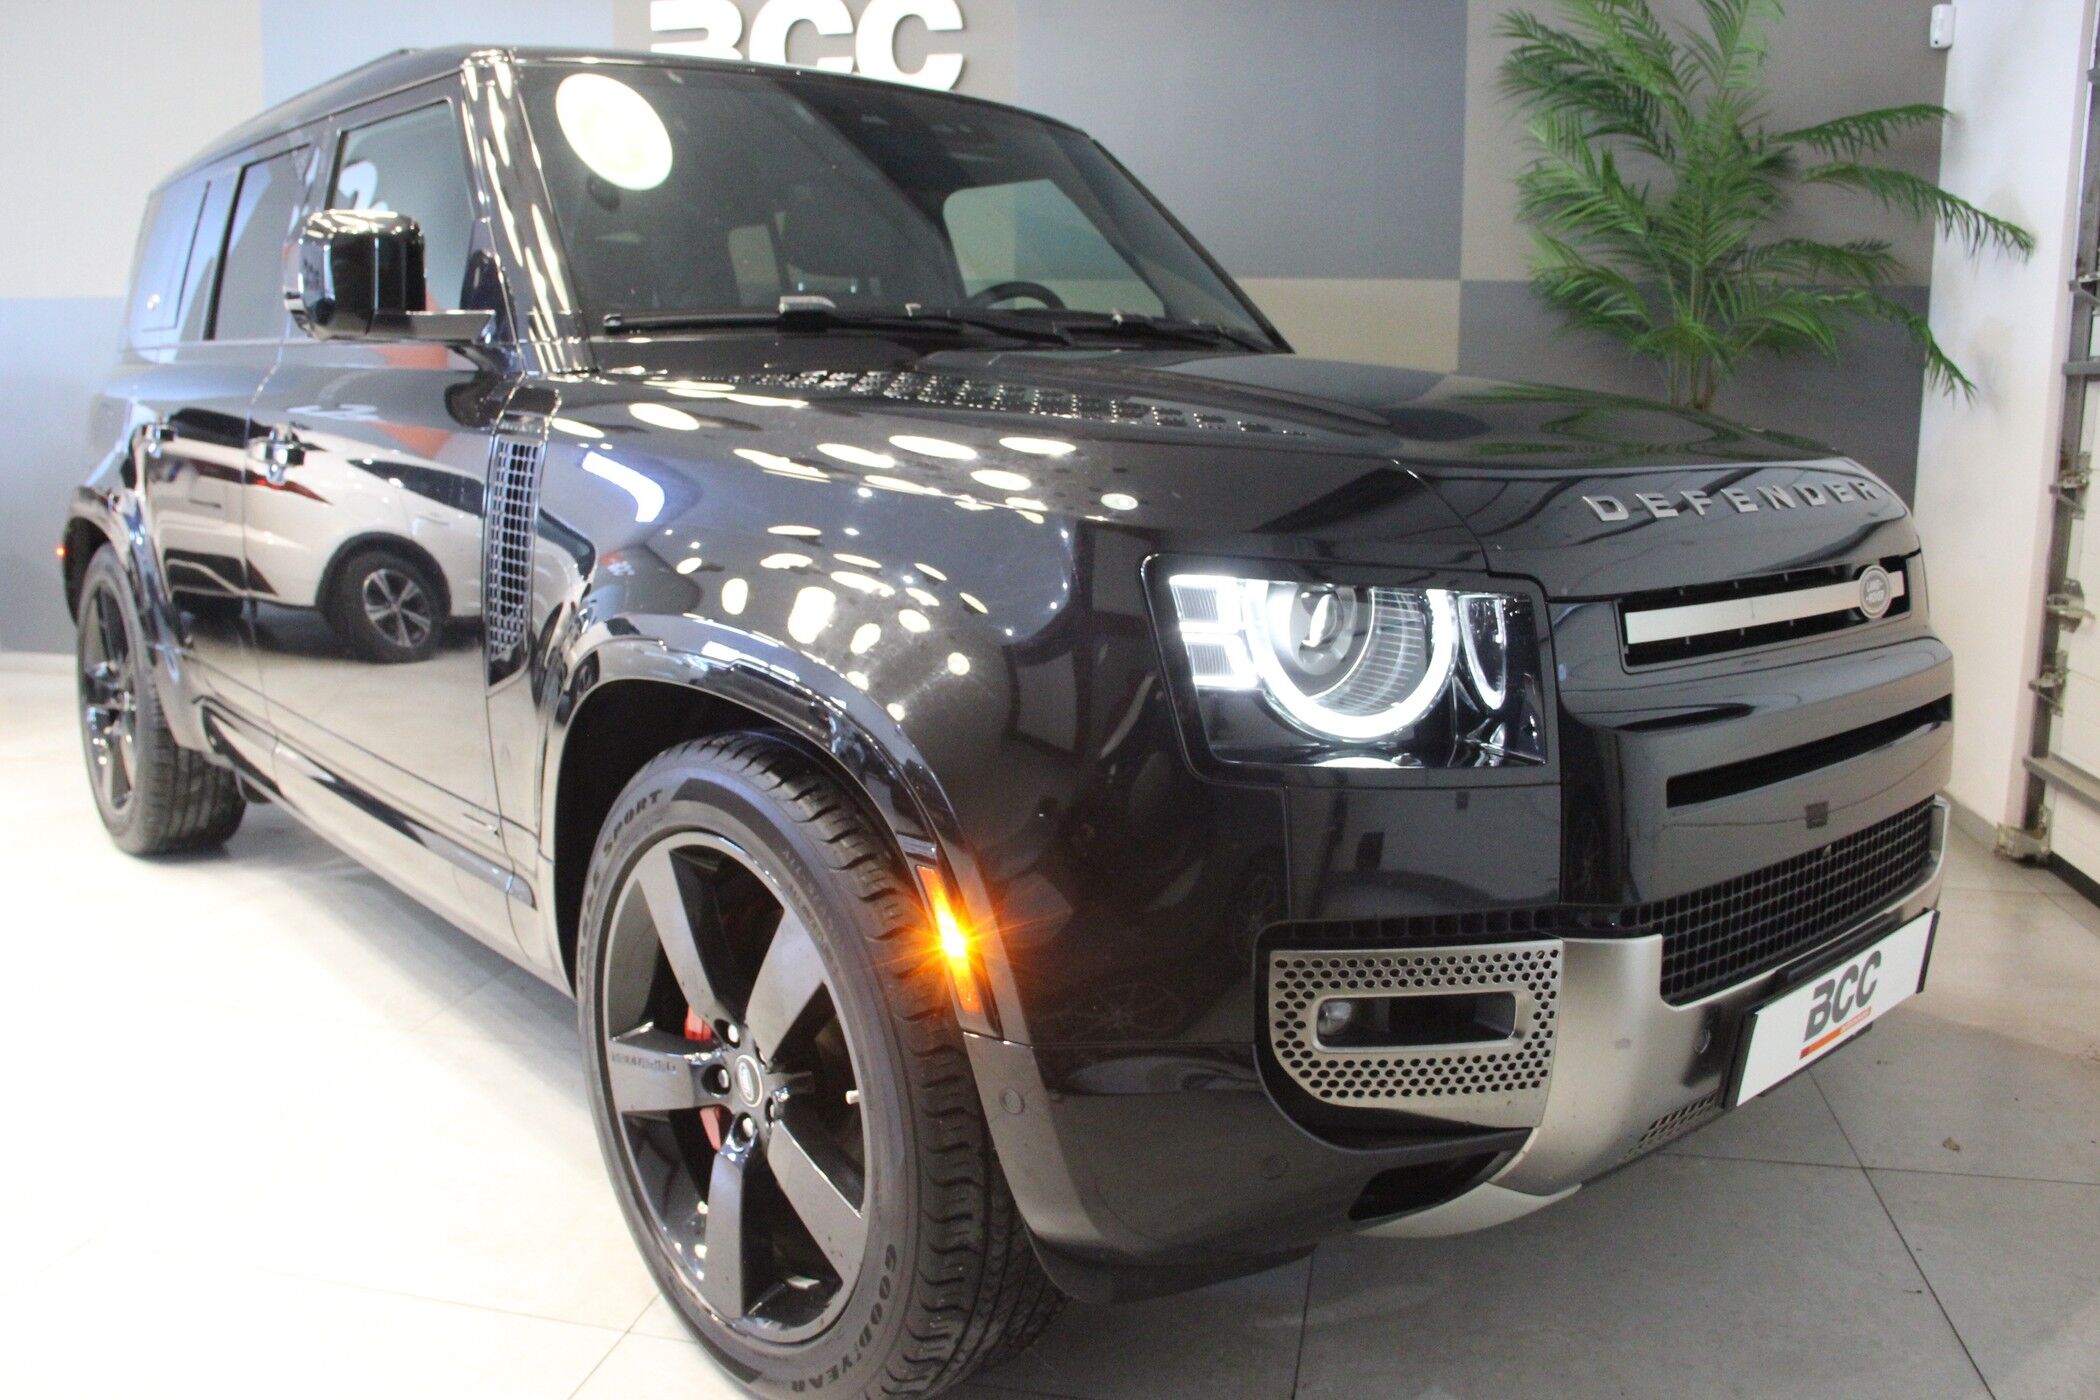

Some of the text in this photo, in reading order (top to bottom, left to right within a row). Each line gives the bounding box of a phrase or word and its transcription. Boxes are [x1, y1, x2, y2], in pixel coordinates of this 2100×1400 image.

[1582, 479, 1878, 523] DEFENDER
[603, 788, 663, 858] SPORT
[1803, 950, 1882, 1043] BCC
[791, 1243, 898, 1393] GOODYEAR
